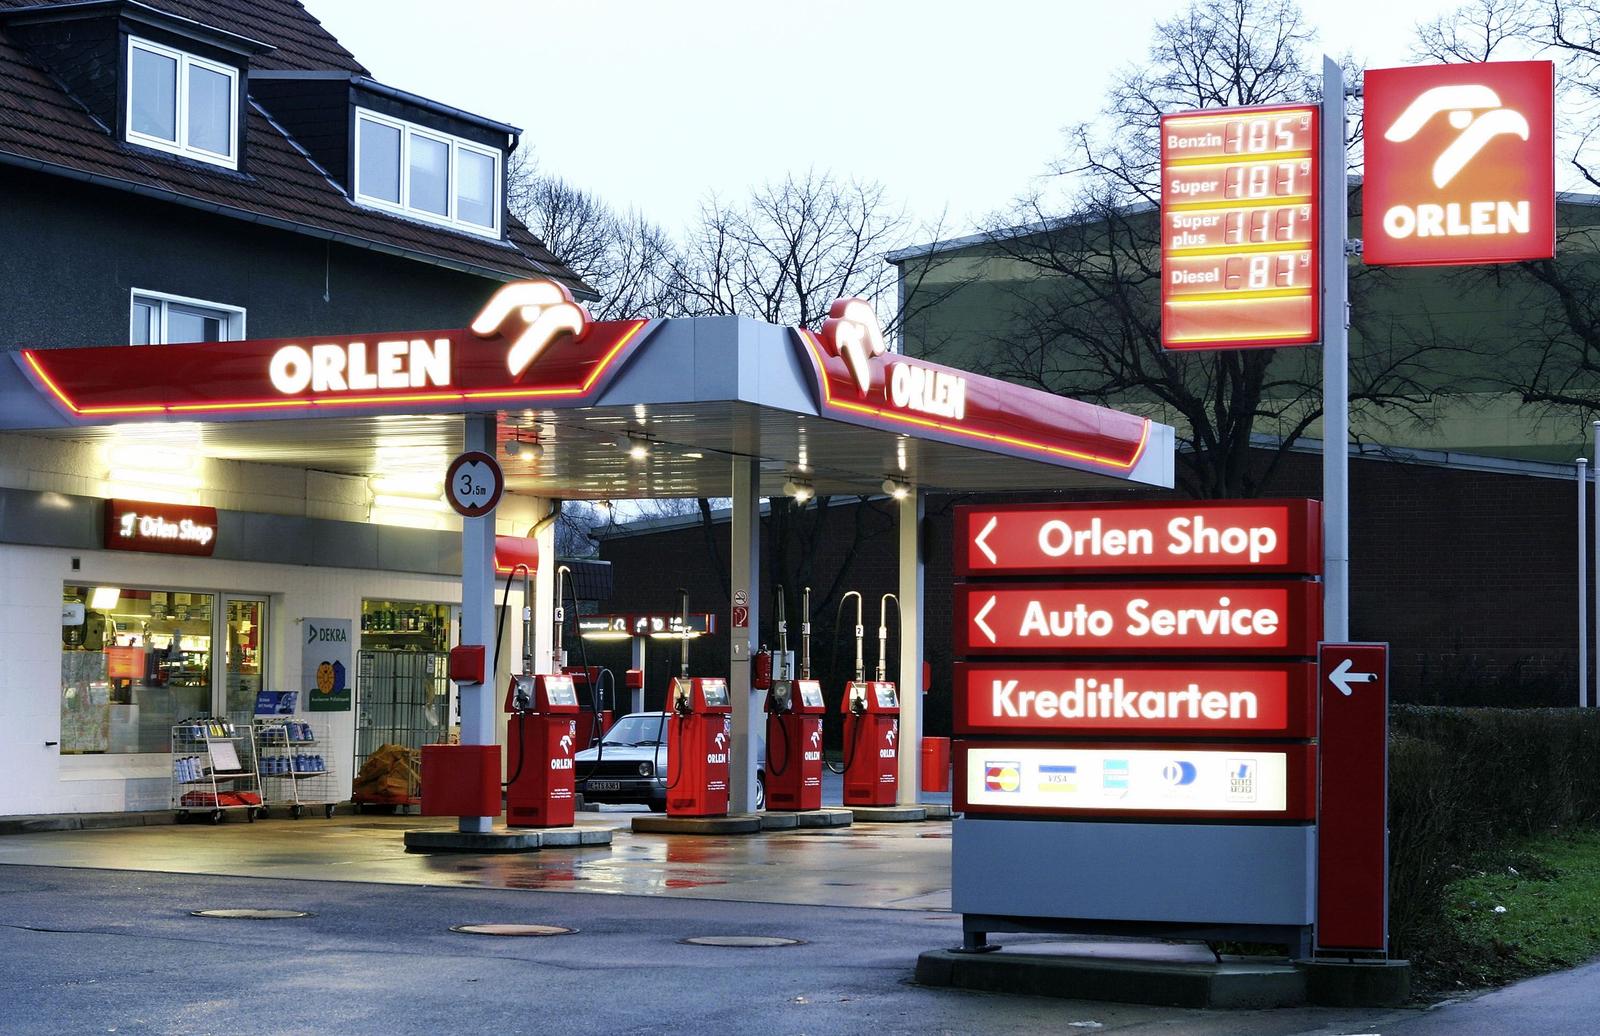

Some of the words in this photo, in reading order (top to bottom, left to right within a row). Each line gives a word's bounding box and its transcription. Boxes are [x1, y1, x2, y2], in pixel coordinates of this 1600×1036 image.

[1168, 135, 1222, 149] Benzin
[1171, 179, 1219, 196] Super
[1172, 214, 1220, 230] Super
[1383, 201, 1530, 239] ORLEN
[1172, 232, 1206, 248] plus
[1171, 268, 1219, 284] Diesel
[269, 339, 450, 394] ORLEN
[891, 362, 966, 420] ORLEN
[140, 516, 179, 538] Orlen
[179, 519, 213, 545] Shop
[1038, 518, 1153, 556] Orlen
[1167, 516, 1277, 562] Shop
[1019, 601, 1113, 636] Auto
[1126, 596, 1279, 635] Service
[320, 628, 347, 642] DEKRA
[992, 678, 1258, 719] Kreditkarten
[708, 754, 726, 763] ORLEN
[805, 751, 820, 760] ORLEN
[880, 749, 895, 758] ORLEN
[551, 759, 572, 769] ORLEN
[1048, 775, 1068, 783] VISA
